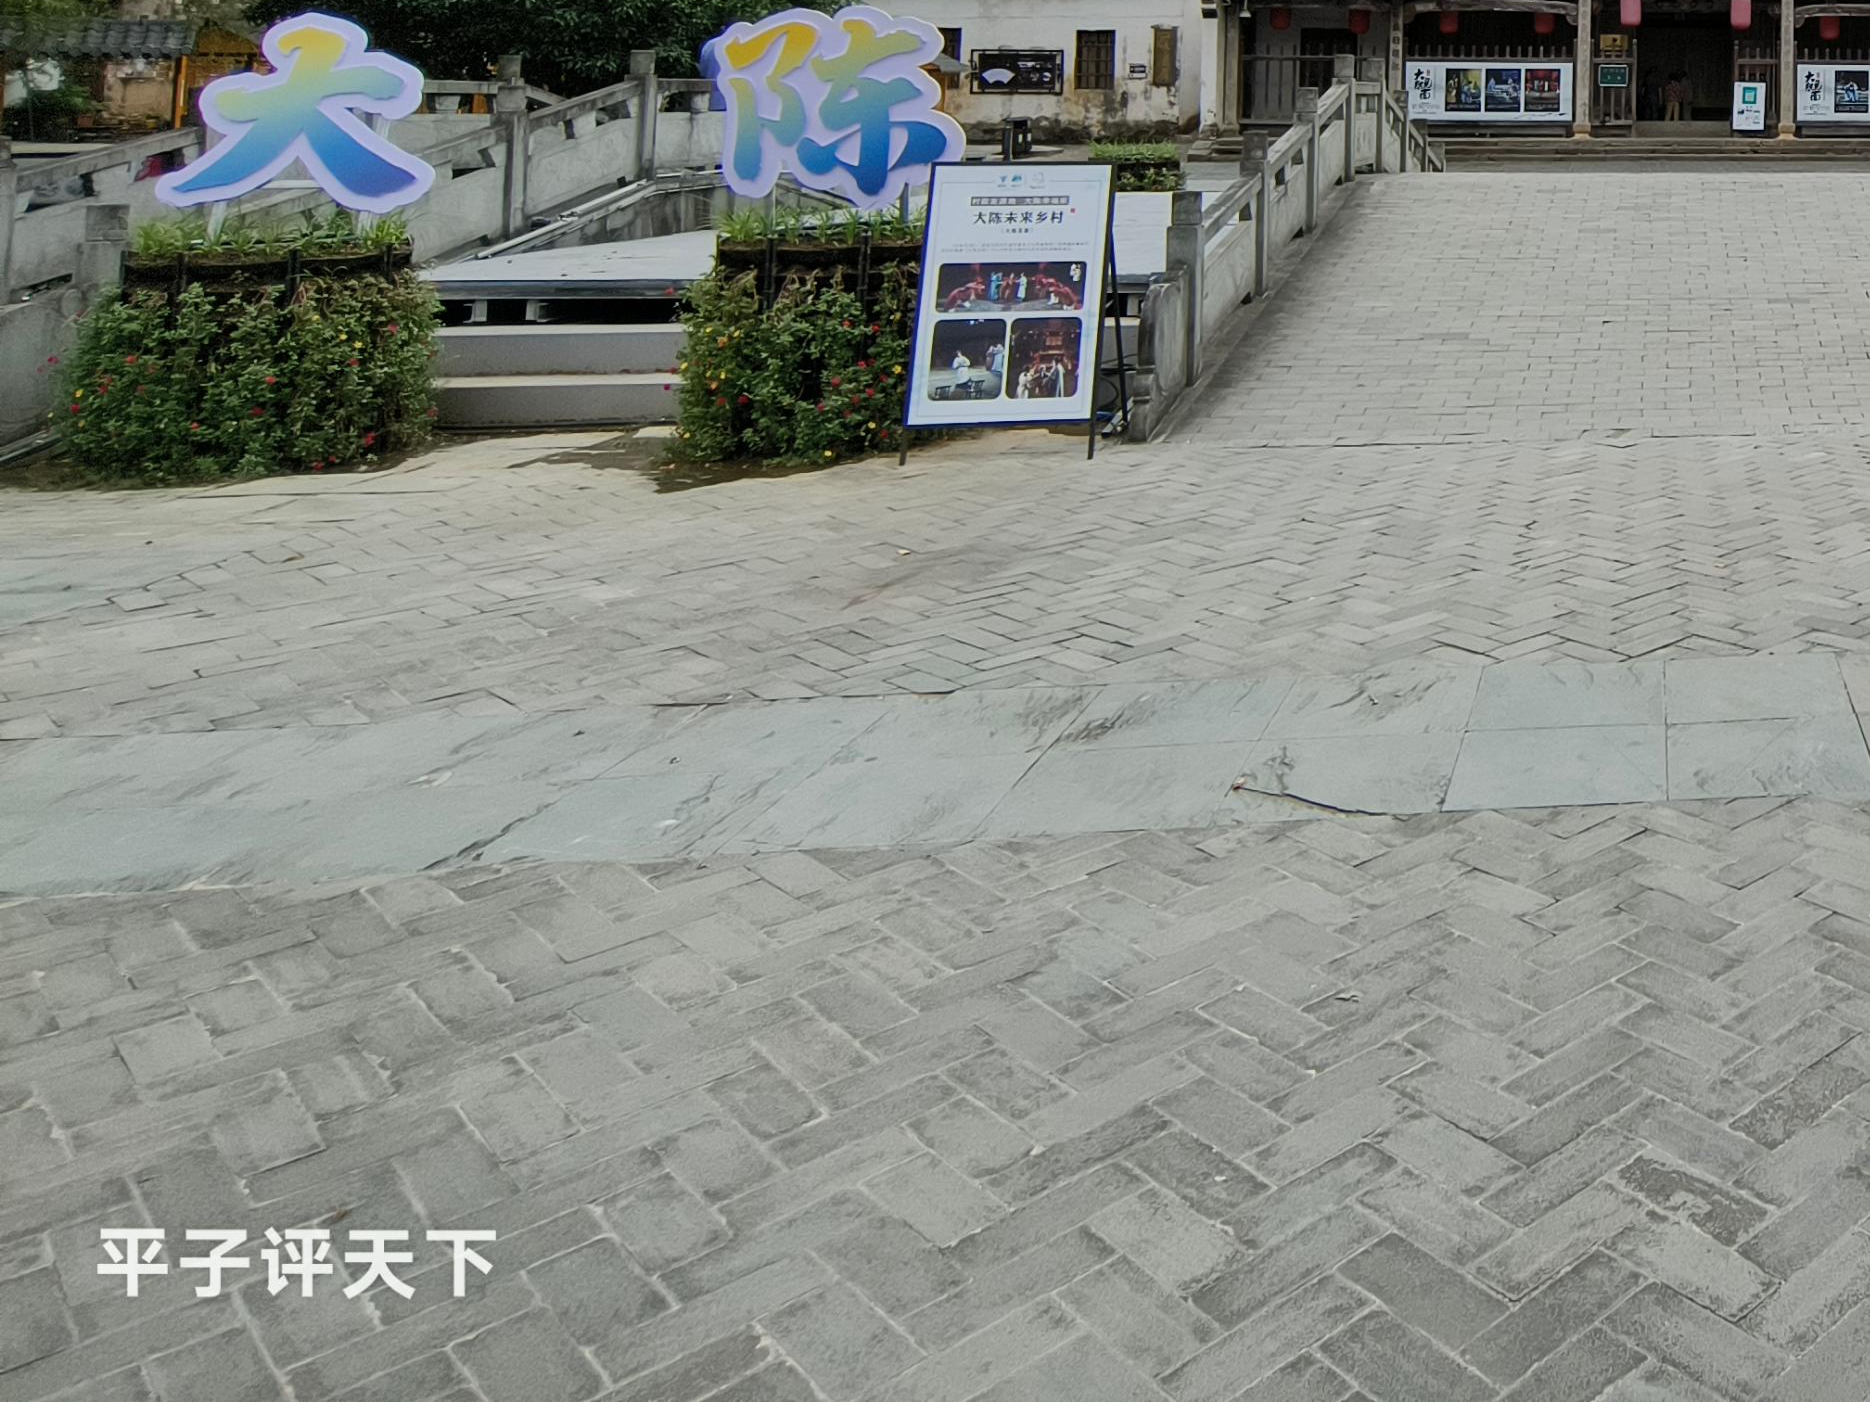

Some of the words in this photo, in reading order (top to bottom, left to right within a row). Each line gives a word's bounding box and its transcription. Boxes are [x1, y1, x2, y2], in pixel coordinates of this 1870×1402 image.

[170, 24, 419, 200] 大
[723, 17, 949, 197] 陈
[973, 210, 1064, 225] 大陈未来乡村
